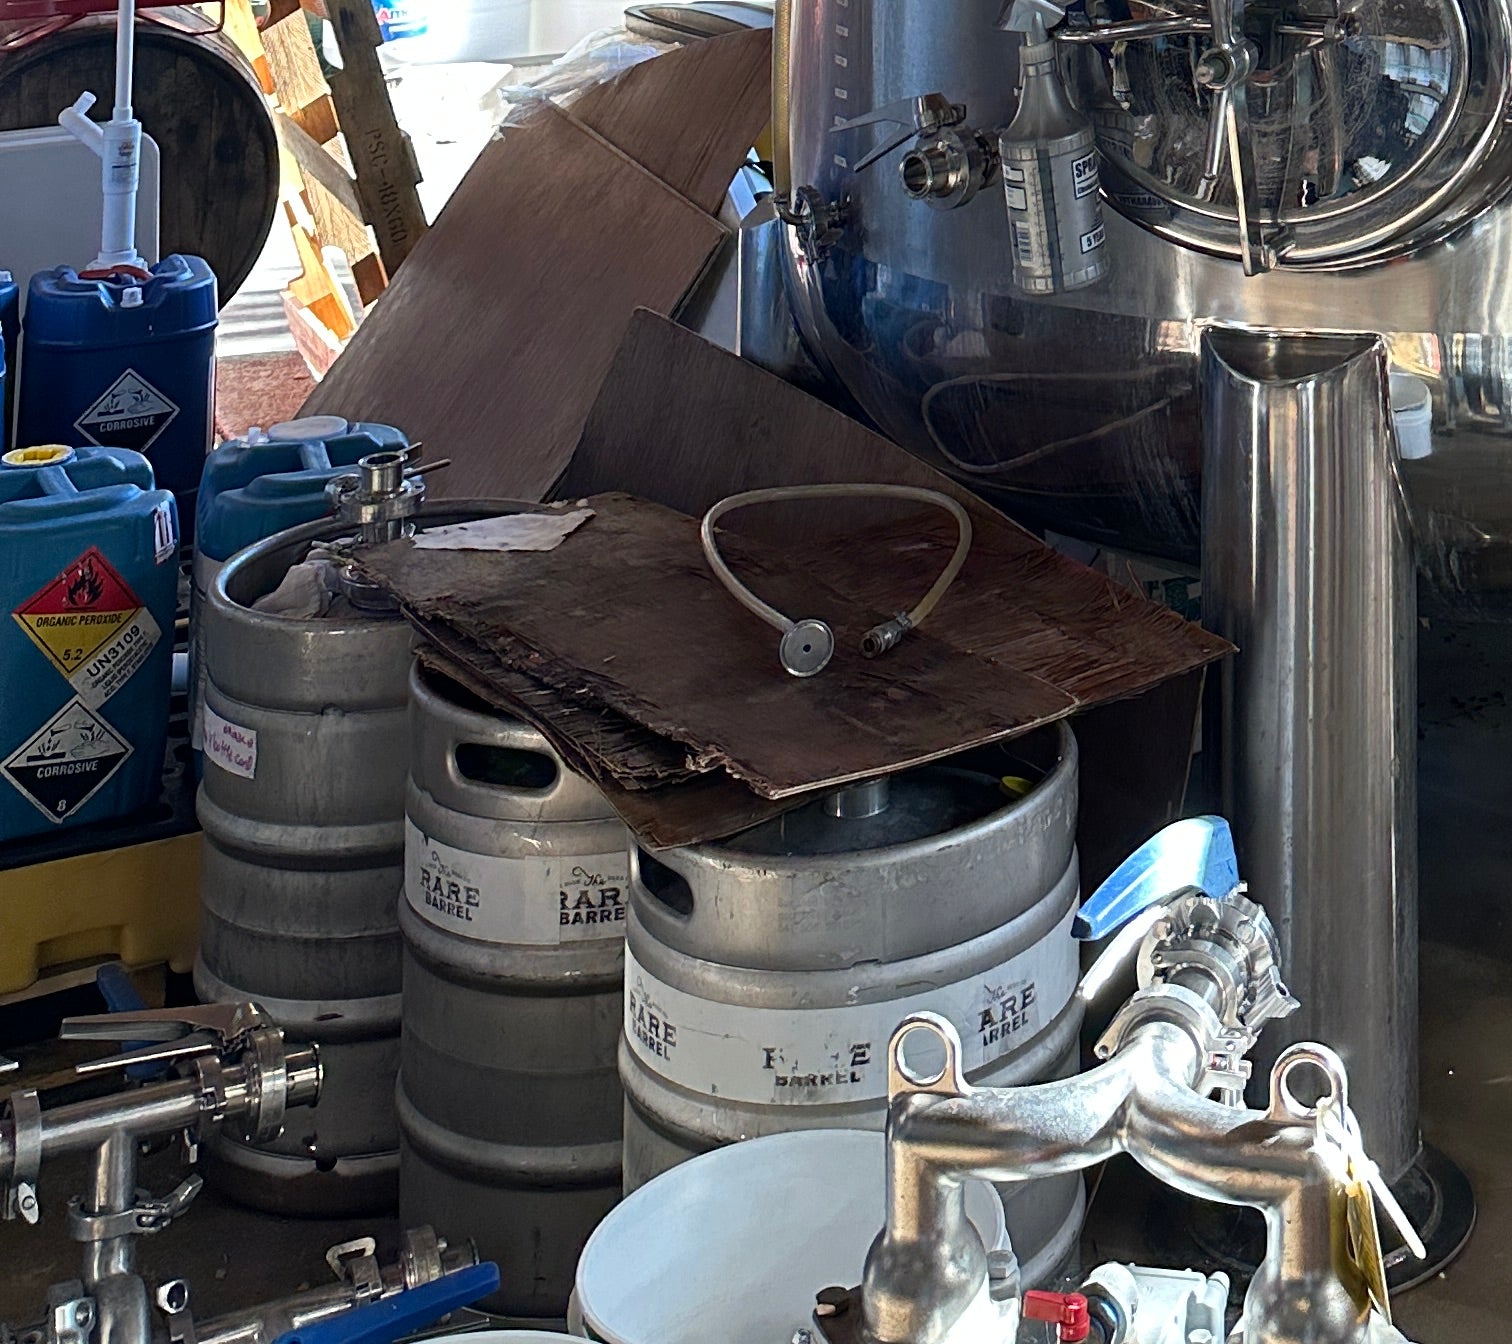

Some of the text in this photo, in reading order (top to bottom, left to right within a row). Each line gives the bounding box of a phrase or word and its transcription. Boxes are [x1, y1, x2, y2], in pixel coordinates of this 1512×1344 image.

[99, 415, 155, 433] CORROSIVE
[36, 613, 122, 628] ORGANIC PEROXIDE
[62, 648, 83, 661] 5.2
[86, 624, 140, 678] UN3109
[36, 760, 98, 779] CORROSIVE
[56, 799, 66, 812] 8
[571, 865, 607, 886] The
[419, 865, 480, 908] RARE
[425, 891, 473, 922] BARREL
[560, 907, 625, 926] BARRE
[977, 981, 1035, 1033] ARE
[629, 989, 677, 1048] RARE
